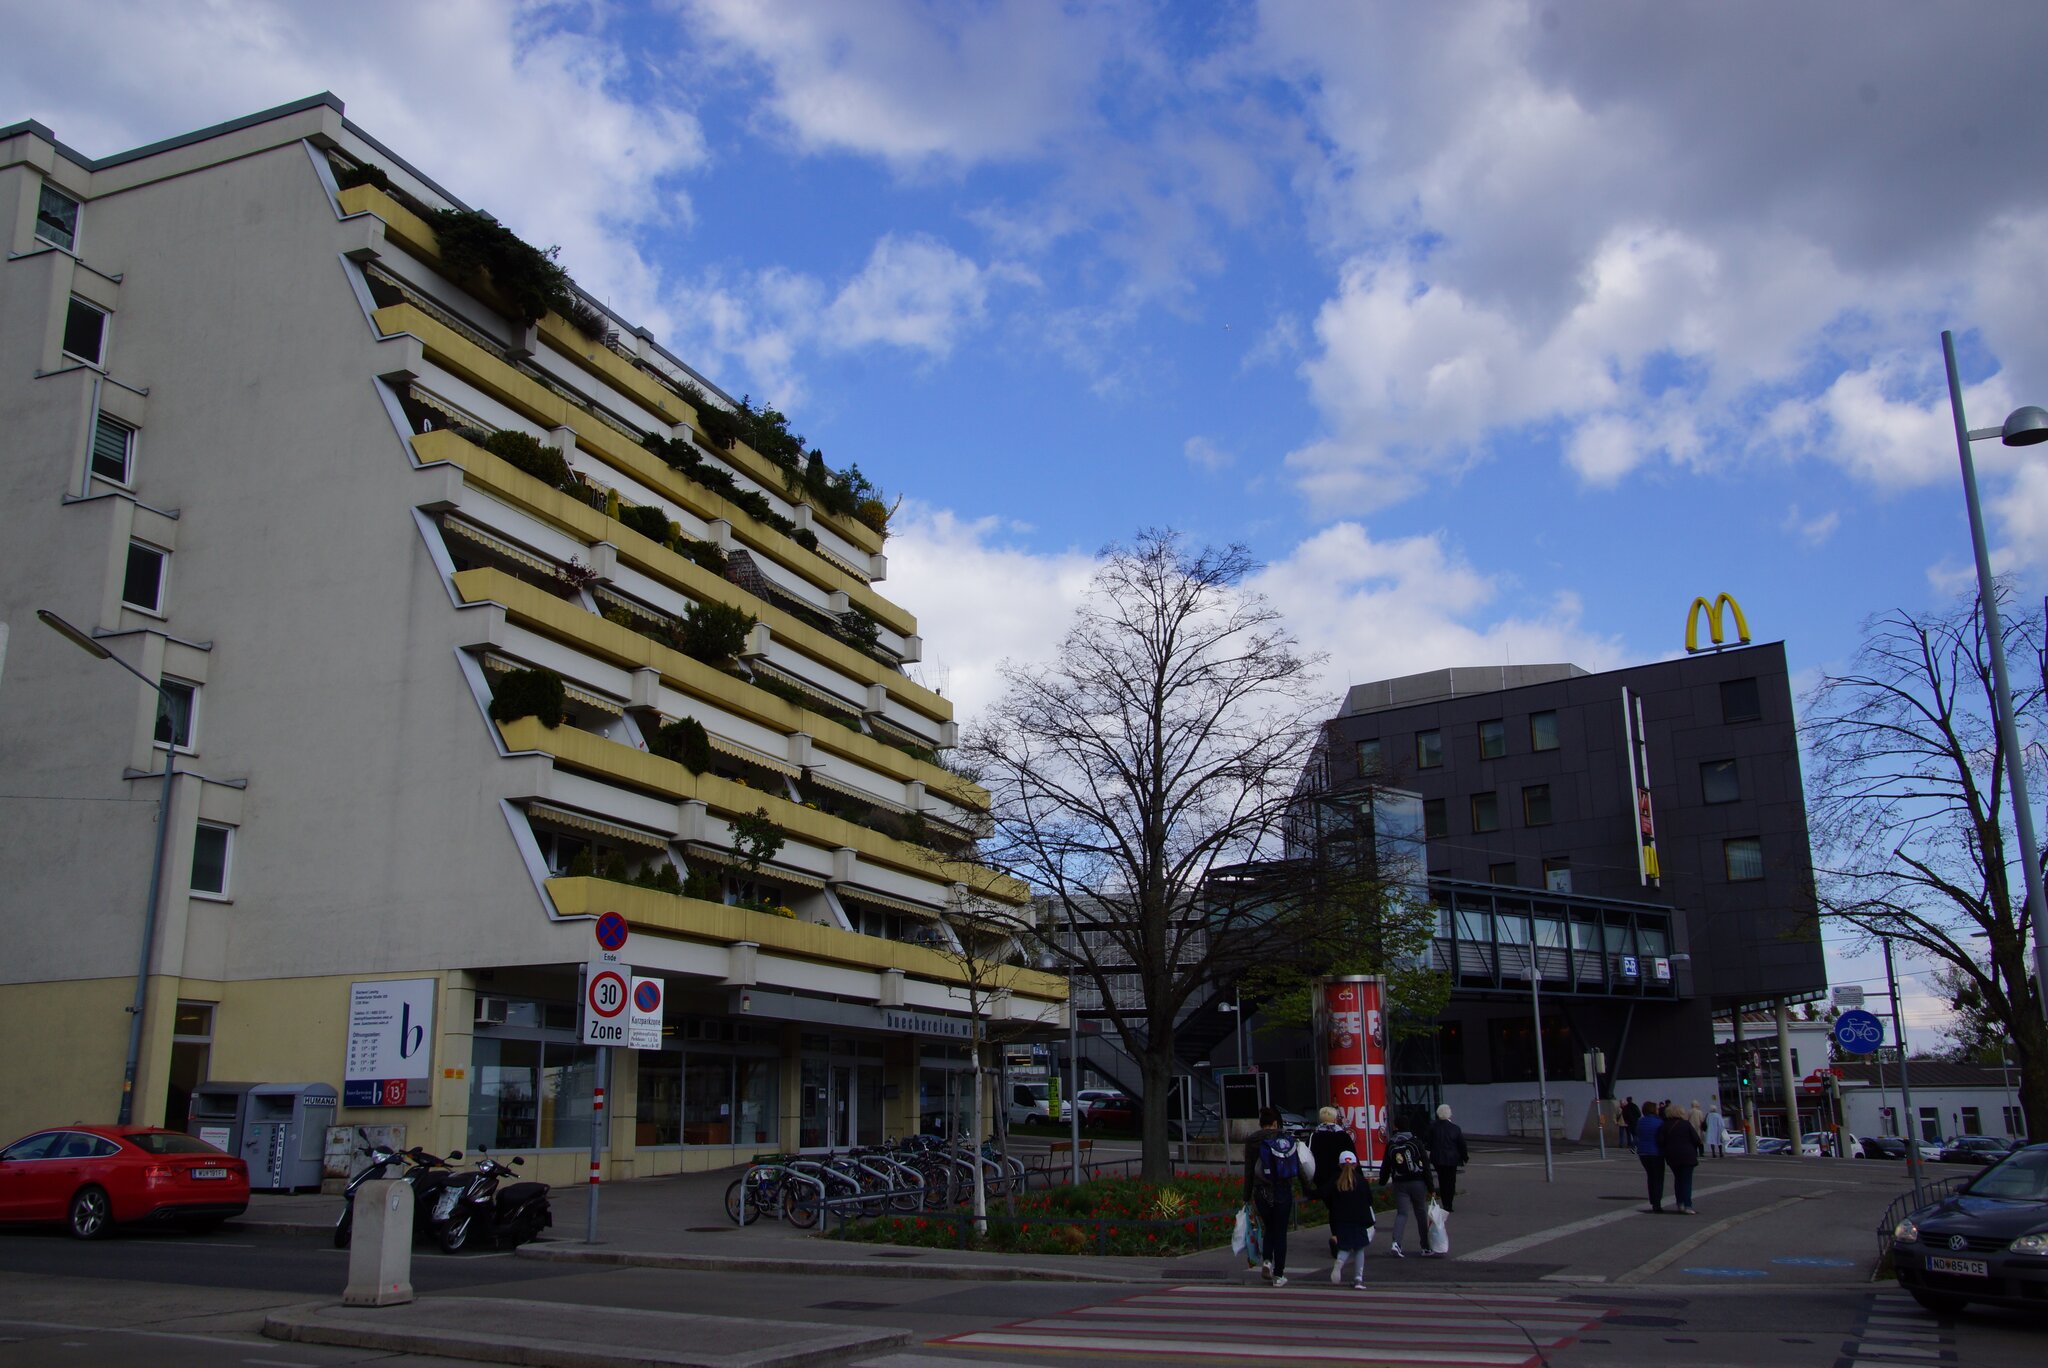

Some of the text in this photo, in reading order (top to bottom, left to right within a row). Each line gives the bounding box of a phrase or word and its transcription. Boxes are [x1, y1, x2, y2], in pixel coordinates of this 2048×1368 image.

[604, 953, 617, 961] Ende
[600, 984, 617, 1005] 30
[591, 1020, 622, 1040] Zone
[304, 1097, 335, 1105] HUMANA
[391, 1086, 400, 1100] 13
[267, 1127, 276, 1173] SCHUHE
[274, 1127, 285, 1185] KLEIDUNG
[1933, 1259, 1983, 1274] ND 854 CE
